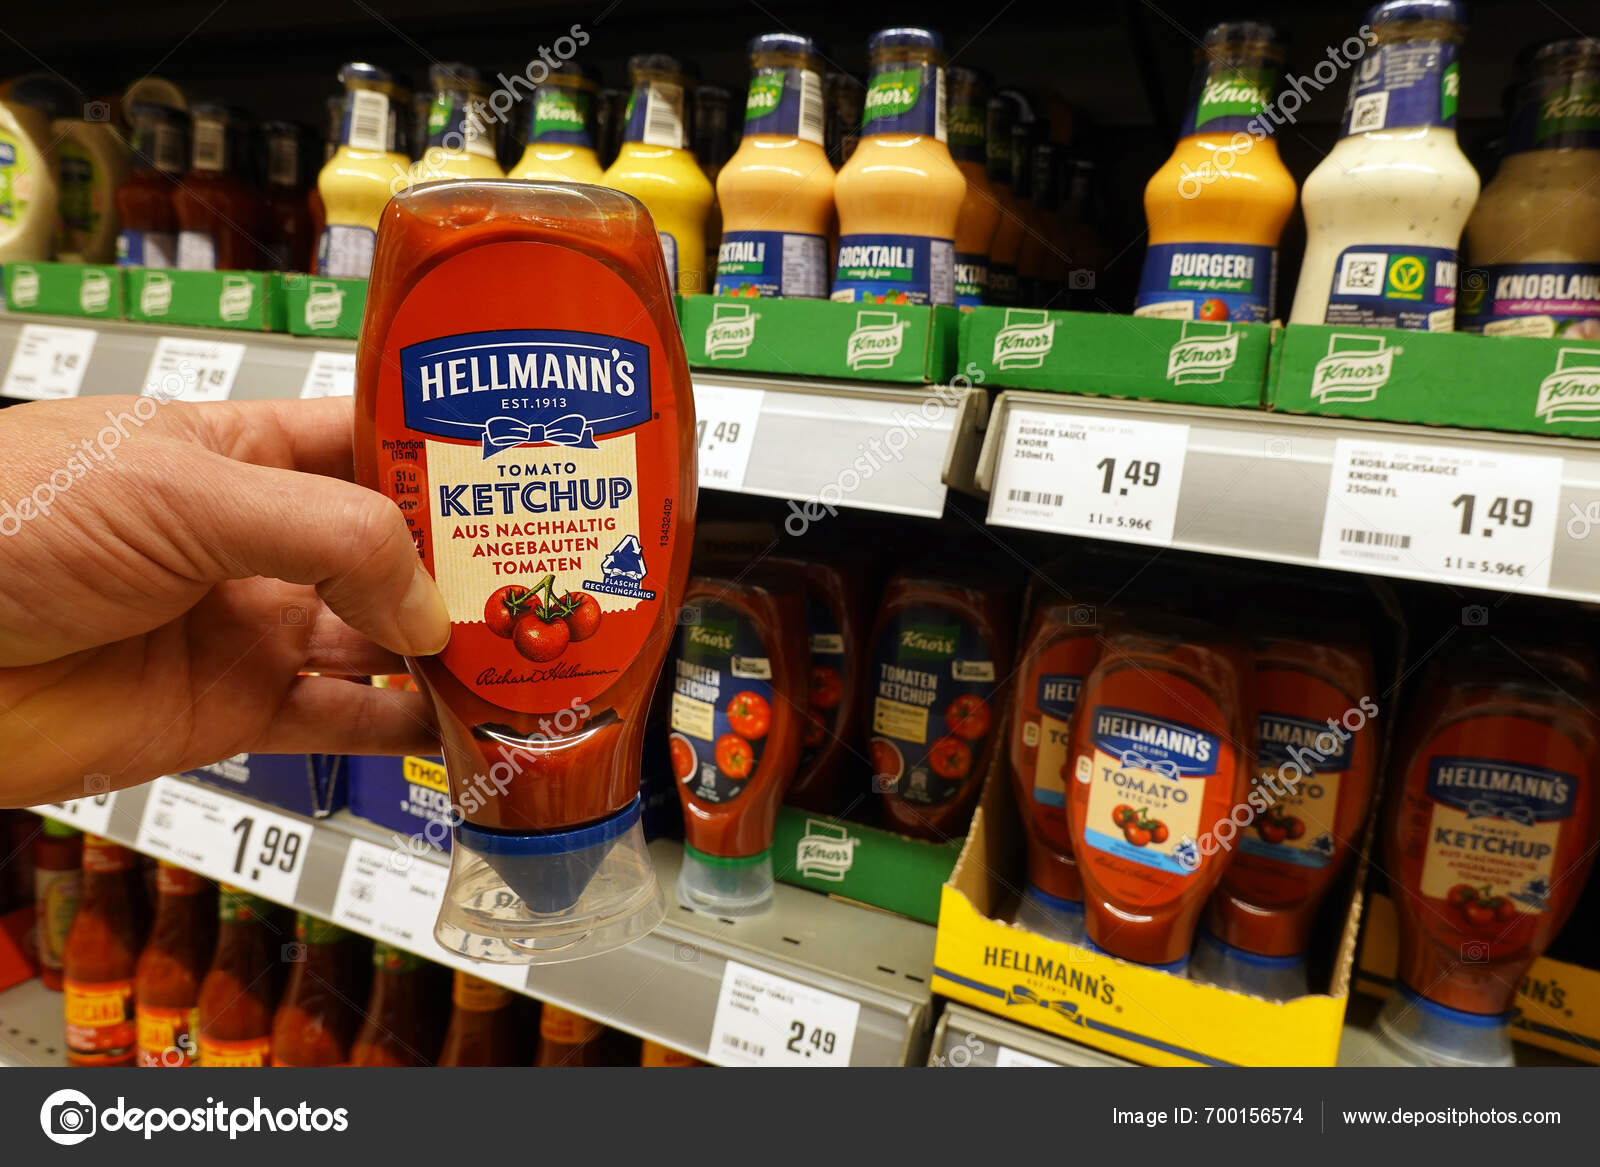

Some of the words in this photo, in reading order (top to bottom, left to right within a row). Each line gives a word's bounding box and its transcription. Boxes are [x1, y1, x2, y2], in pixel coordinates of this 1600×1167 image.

[838, 245, 908, 268] COCKTAIL
[1170, 252, 1246, 278] BURGER
[1495, 273, 1600, 300] KNOBLAUC
[710, 326, 752, 344] Knorr
[852, 331, 900, 353] Knorr
[997, 332, 1050, 350] Knorr
[1170, 344, 1233, 364] Knorr
[419, 348, 636, 402] HELLMANN'S
[1319, 361, 1385, 383] Knorr
[1547, 378, 1600, 402] Kno
[501, 397, 567, 409] EST.1913
[382, 440, 395, 450] Pro
[396, 440, 424, 450] Portion
[1017, 438, 1048, 448] KNORR
[1019, 427, 1055, 437] BURGER
[1058, 430, 1087, 440] SAUCE
[497, 462, 577, 477] TOMATO
[1096, 457, 1162, 496] 1.49
[1349, 471, 1388, 482] KNORR
[1351, 458, 1458, 476] KNOBLAUCHSAUCE
[439, 477, 633, 518] KETCHUP
[659, 498, 673, 547] 13432402
[1116, 516, 1153, 531] 5.96€
[1450, 493, 1534, 538] 1.49
[452, 523, 490, 540] AUS
[496, 517, 616, 538] NACHHALTIG
[472, 537, 599, 558] ANGEBAUTEN
[492, 556, 582, 576] TOMATEN
[1480, 560, 1526, 577] 5.96€
[604, 577, 639, 589] FLASCHE
[881, 663, 938, 690] TOMATEN
[880, 681, 937, 706] KETCHUP
[1097, 714, 1211, 762] HELLMANN'S
[1102, 767, 1188, 804] TOMATO
[1437, 766, 1569, 804] HELLMANN'S
[233, 815, 302, 881] 1.99
[802, 845, 848, 861] Knorr
[1434, 827, 1551, 861] KETCHUP
[983, 945, 1115, 1005] HELLMANN'S
[786, 1020, 837, 1058] 2.49
